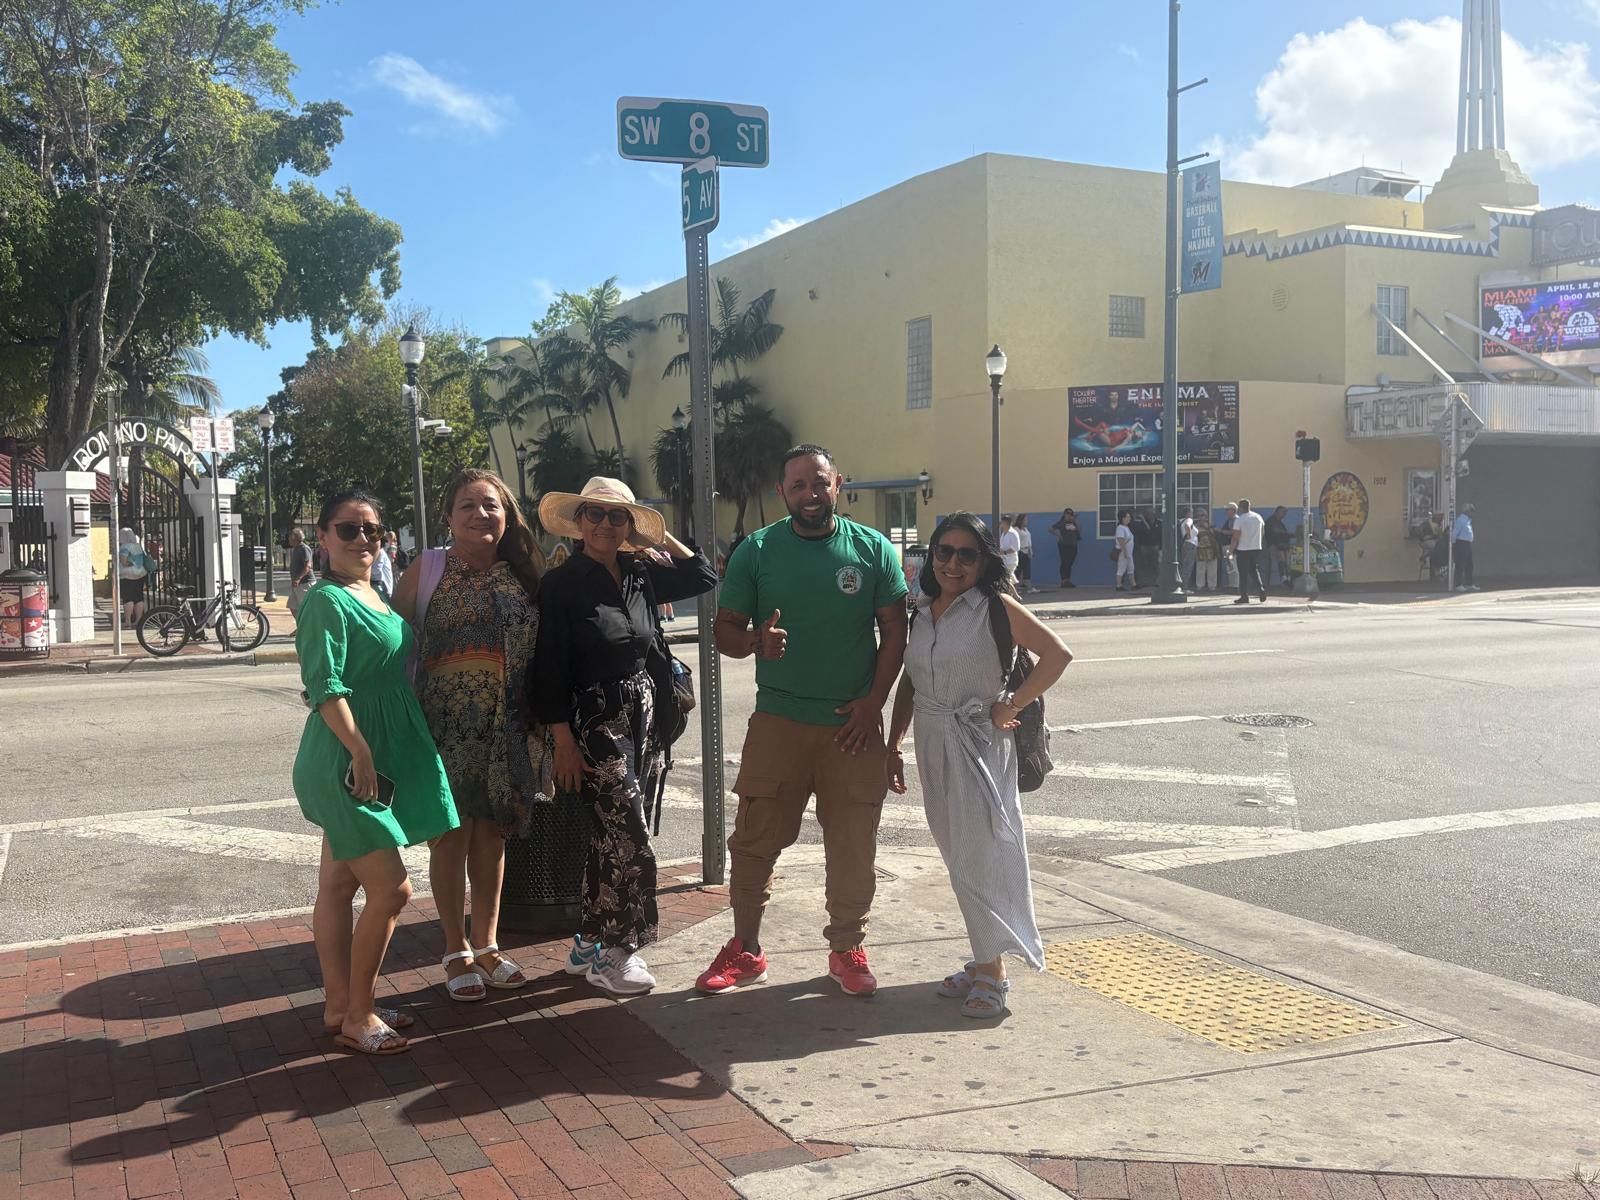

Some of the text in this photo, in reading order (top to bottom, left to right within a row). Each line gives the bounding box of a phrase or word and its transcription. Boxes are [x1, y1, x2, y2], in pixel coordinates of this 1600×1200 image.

[624, 111, 762, 155] SW 8 ST
[700, 177, 713, 210] AV
[1186, 202, 1217, 218] BASEBALL
[1197, 215, 1205, 226] IS
[1191, 225, 1212, 240] LITTLE
[1187, 235, 1216, 252] HAVANA
[1484, 287, 1537, 302] MIAMI
[1546, 284, 1576, 293] APRIL
[1585, 291, 1600, 299] AM
[1072, 396, 1097, 405] THEATER
[1127, 386, 1209, 401] ENIMA
[1073, 456, 1096, 465] Enjoy
[1105, 455, 1138, 464] Magical
[1140, 453, 1191, 463] Expece!
